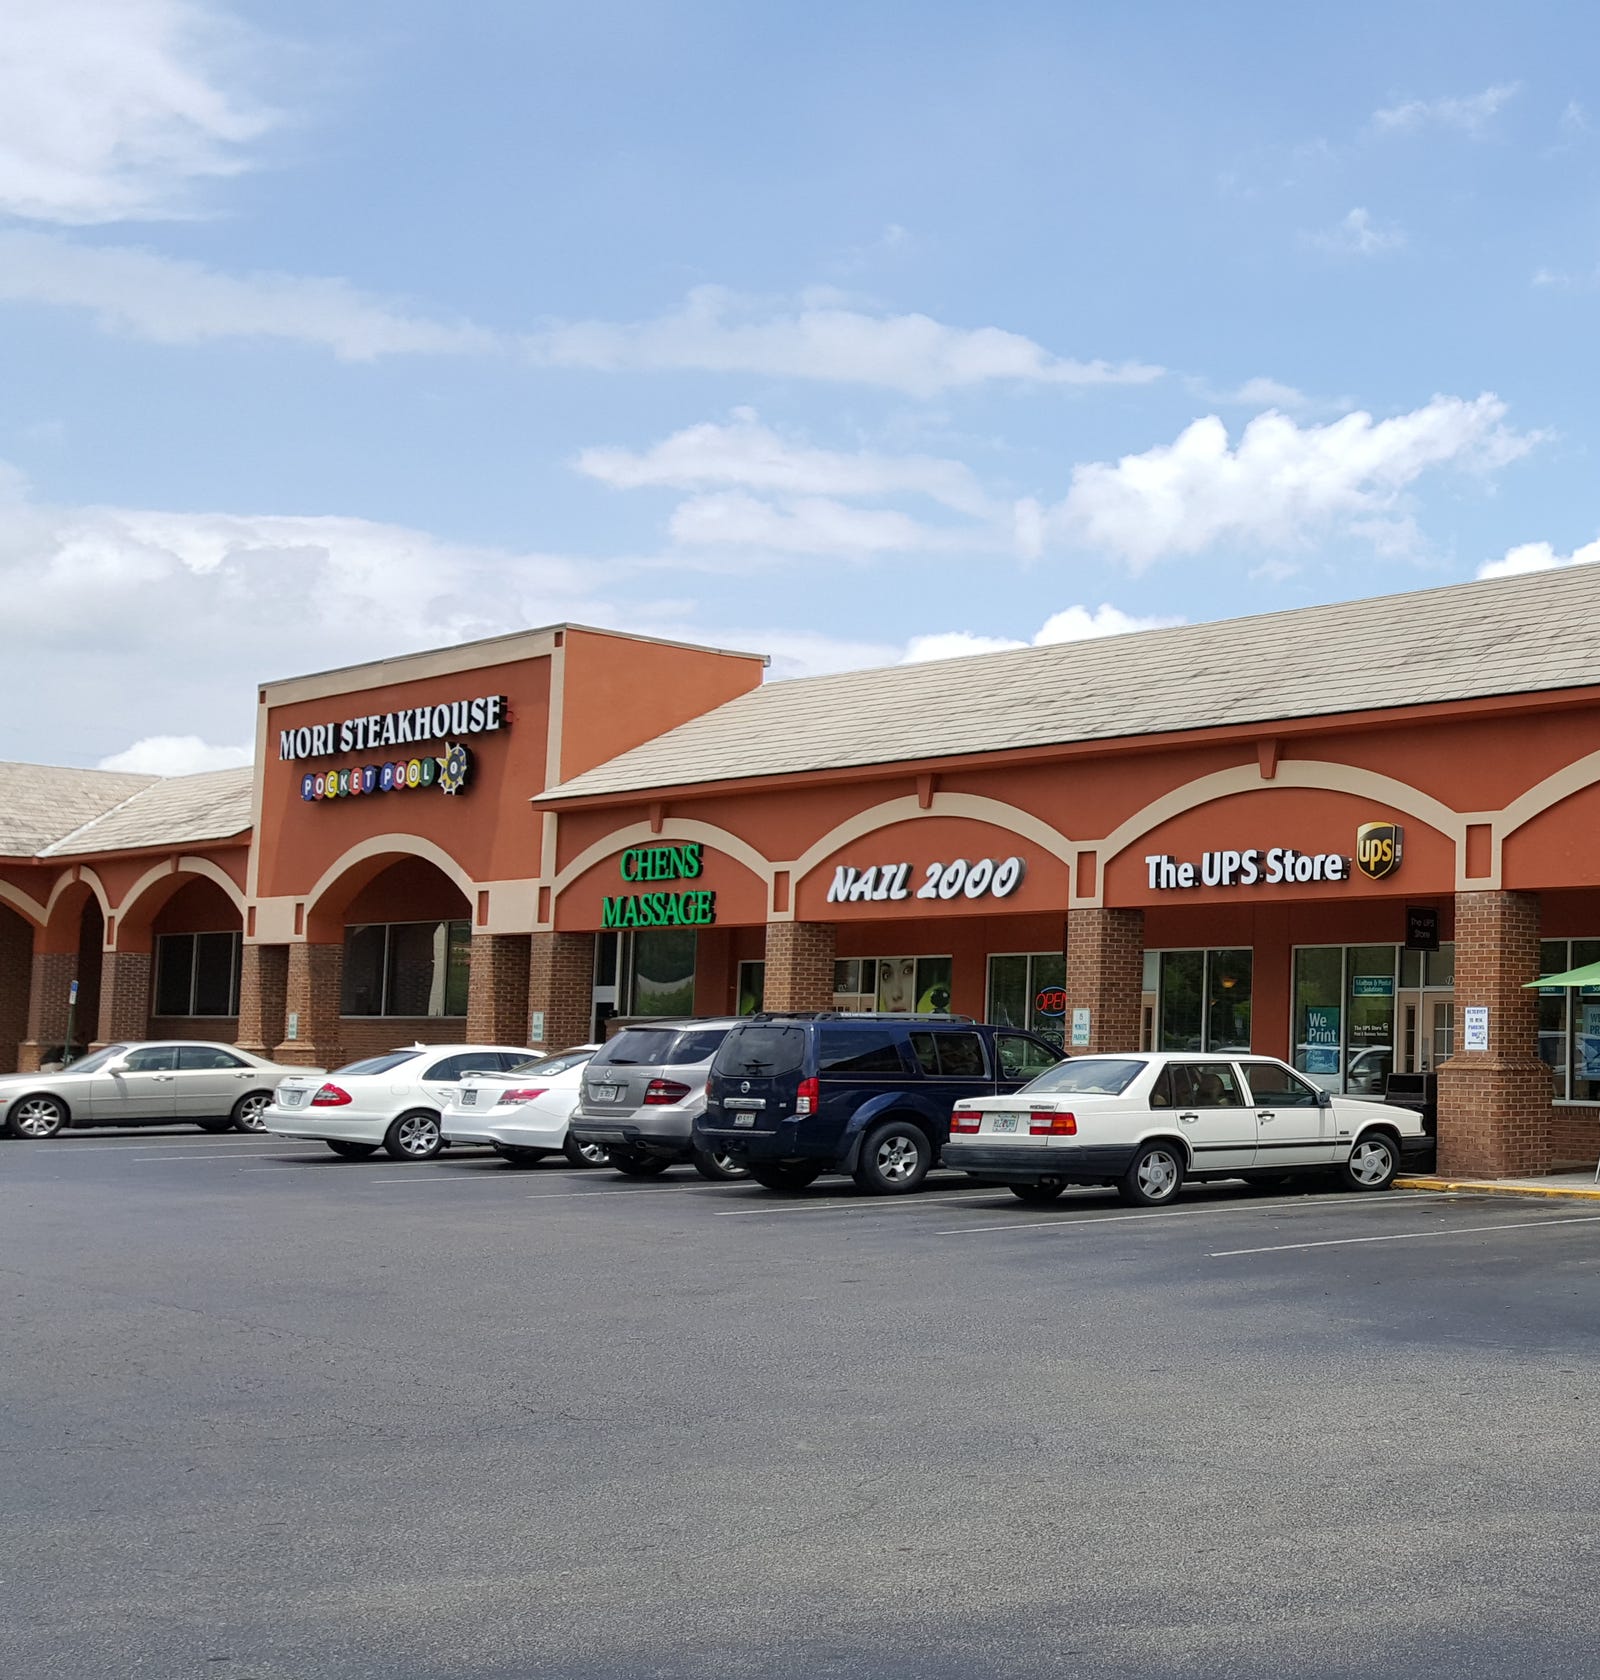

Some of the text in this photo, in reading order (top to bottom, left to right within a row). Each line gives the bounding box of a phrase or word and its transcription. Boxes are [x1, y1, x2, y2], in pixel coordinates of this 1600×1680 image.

[278, 695, 503, 761] MORI STEAKHOUSE
[303, 760, 433, 798] POCKET POOL
[620, 843, 702, 882] CHENS
[1145, 847, 1344, 889] The UPS Store
[1359, 838, 1393, 872] ups
[827, 856, 1023, 903] NAIL 2000
[600, 890, 714, 928] MASSAGE
[1309, 1012, 1327, 1027] We
[1309, 1027, 1336, 1042] Print
